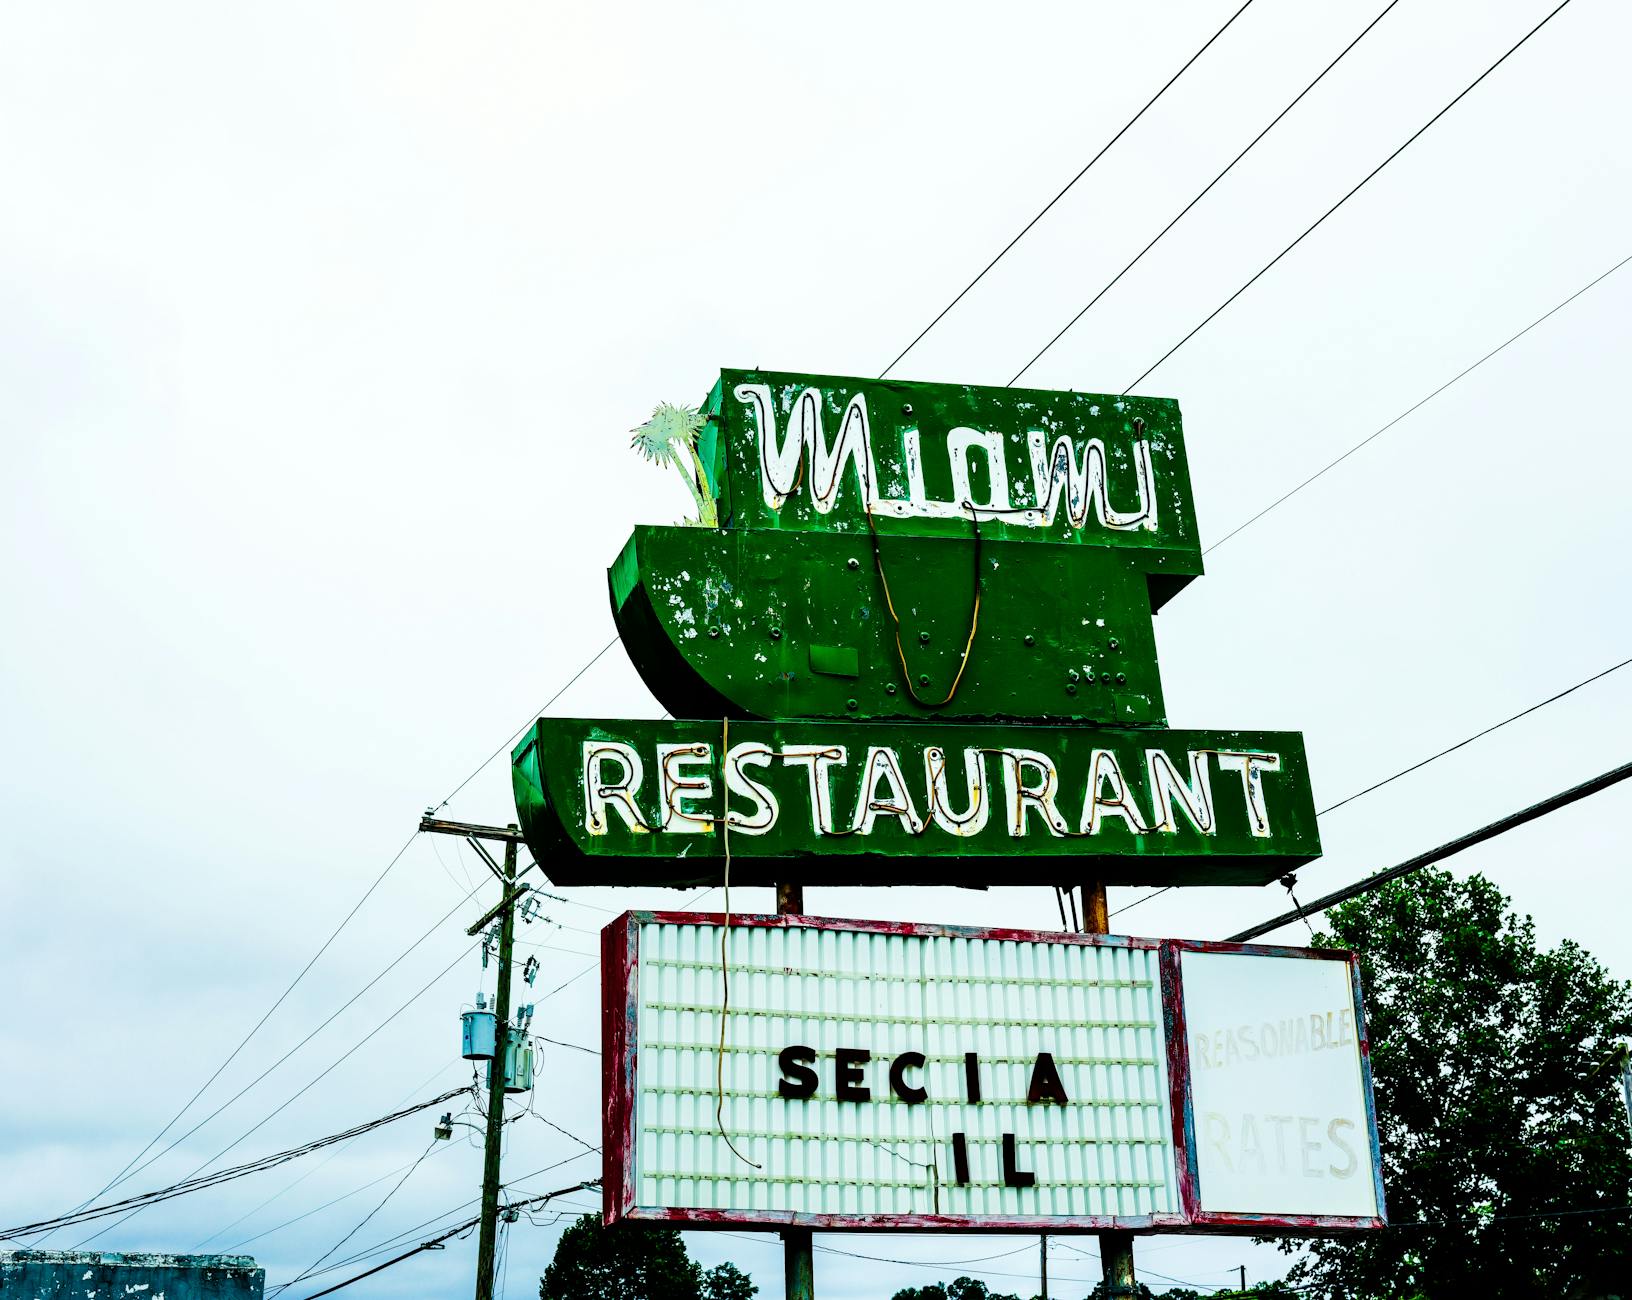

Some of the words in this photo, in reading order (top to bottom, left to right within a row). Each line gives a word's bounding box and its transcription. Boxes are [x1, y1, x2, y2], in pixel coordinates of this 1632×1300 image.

[734, 383, 1159, 532] Miami
[581, 740, 1281, 839] RESTAURANT
[1195, 1008, 1352, 1070] REASONABLE
[1203, 1112, 1358, 1180] RATES
